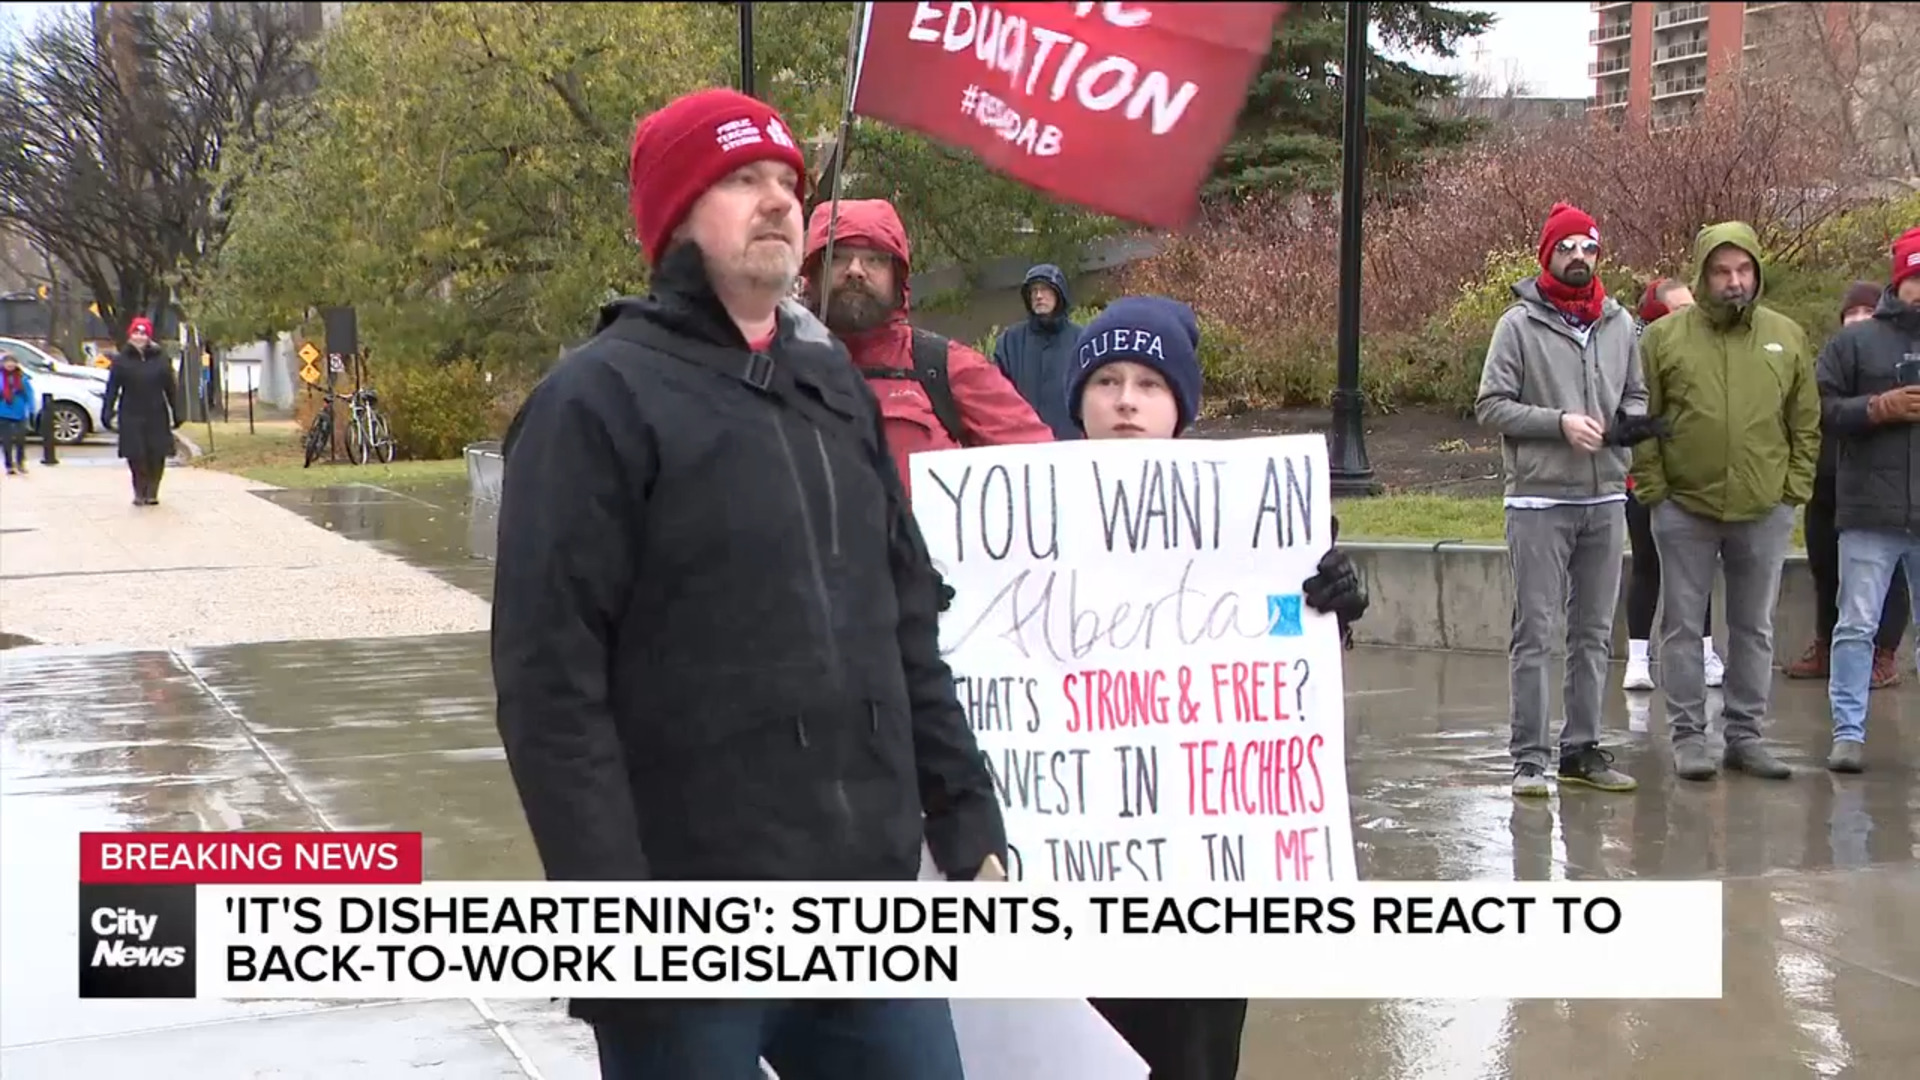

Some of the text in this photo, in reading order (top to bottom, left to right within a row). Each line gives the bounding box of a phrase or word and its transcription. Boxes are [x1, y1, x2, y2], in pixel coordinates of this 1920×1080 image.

[1079, 329, 1165, 369] CUEFA
[929, 456, 1313, 562] YOU WANT AN
[939, 559, 1282, 661] Alberta
[1063, 669, 1170, 732] STRONG
[1178, 666, 1200, 723] &
[1211, 658, 1310, 722] FREE?
[977, 734, 1325, 817] NVEST IN TEACHERS
[1045, 838, 1167, 880] INVEST
